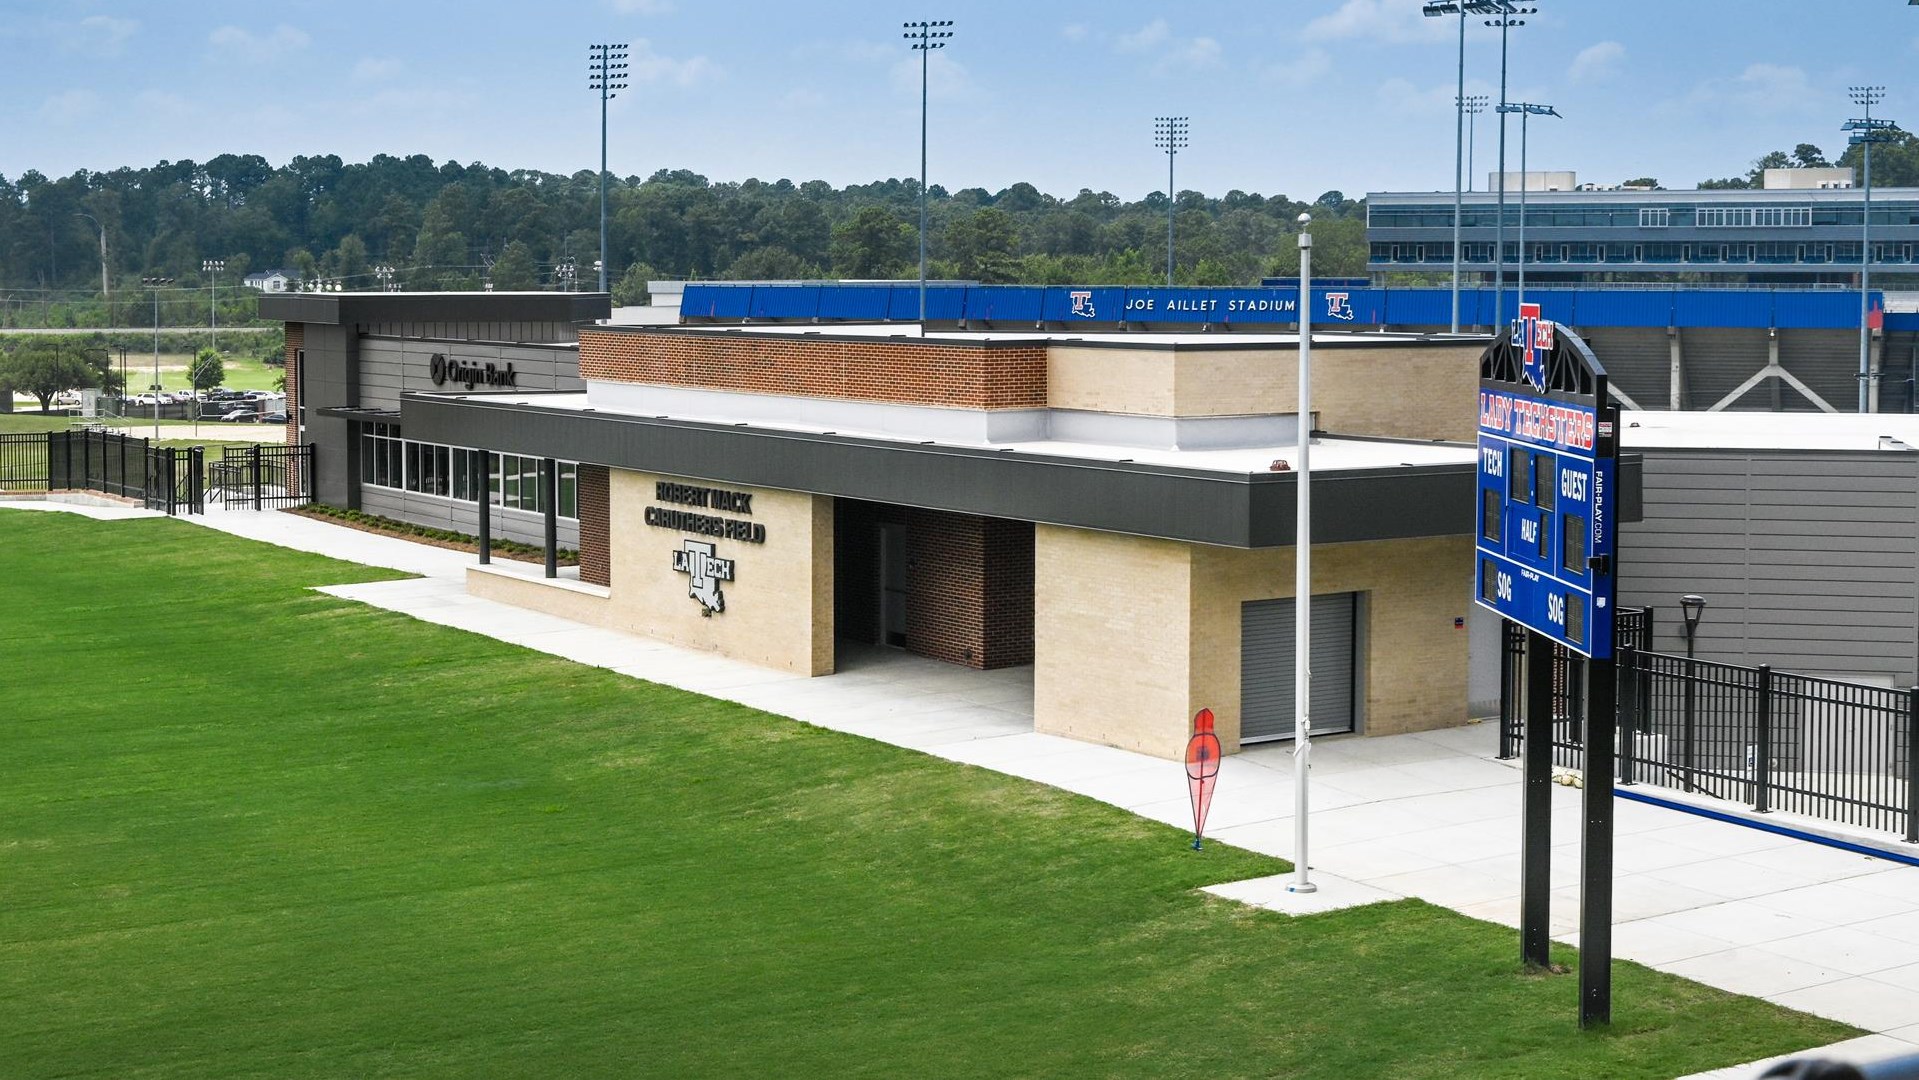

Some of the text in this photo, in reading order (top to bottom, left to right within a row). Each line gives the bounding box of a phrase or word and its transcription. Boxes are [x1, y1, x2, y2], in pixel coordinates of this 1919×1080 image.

[1126, 299, 1295, 311] JOE AILLET STADIUM
[448, 360, 517, 391] Origin Bank
[1480, 393, 1594, 451] LADY TECHSTERS
[1483, 447, 1502, 477] TECH
[656, 481, 752, 515] ROBERT MACK
[1561, 468, 1588, 502] GUEST
[644, 506, 766, 544] CARUTHERS FIELD
[1521, 518, 1538, 544] HALF
[1497, 571, 1512, 602] SOG
[1548, 592, 1564, 625] SOG
